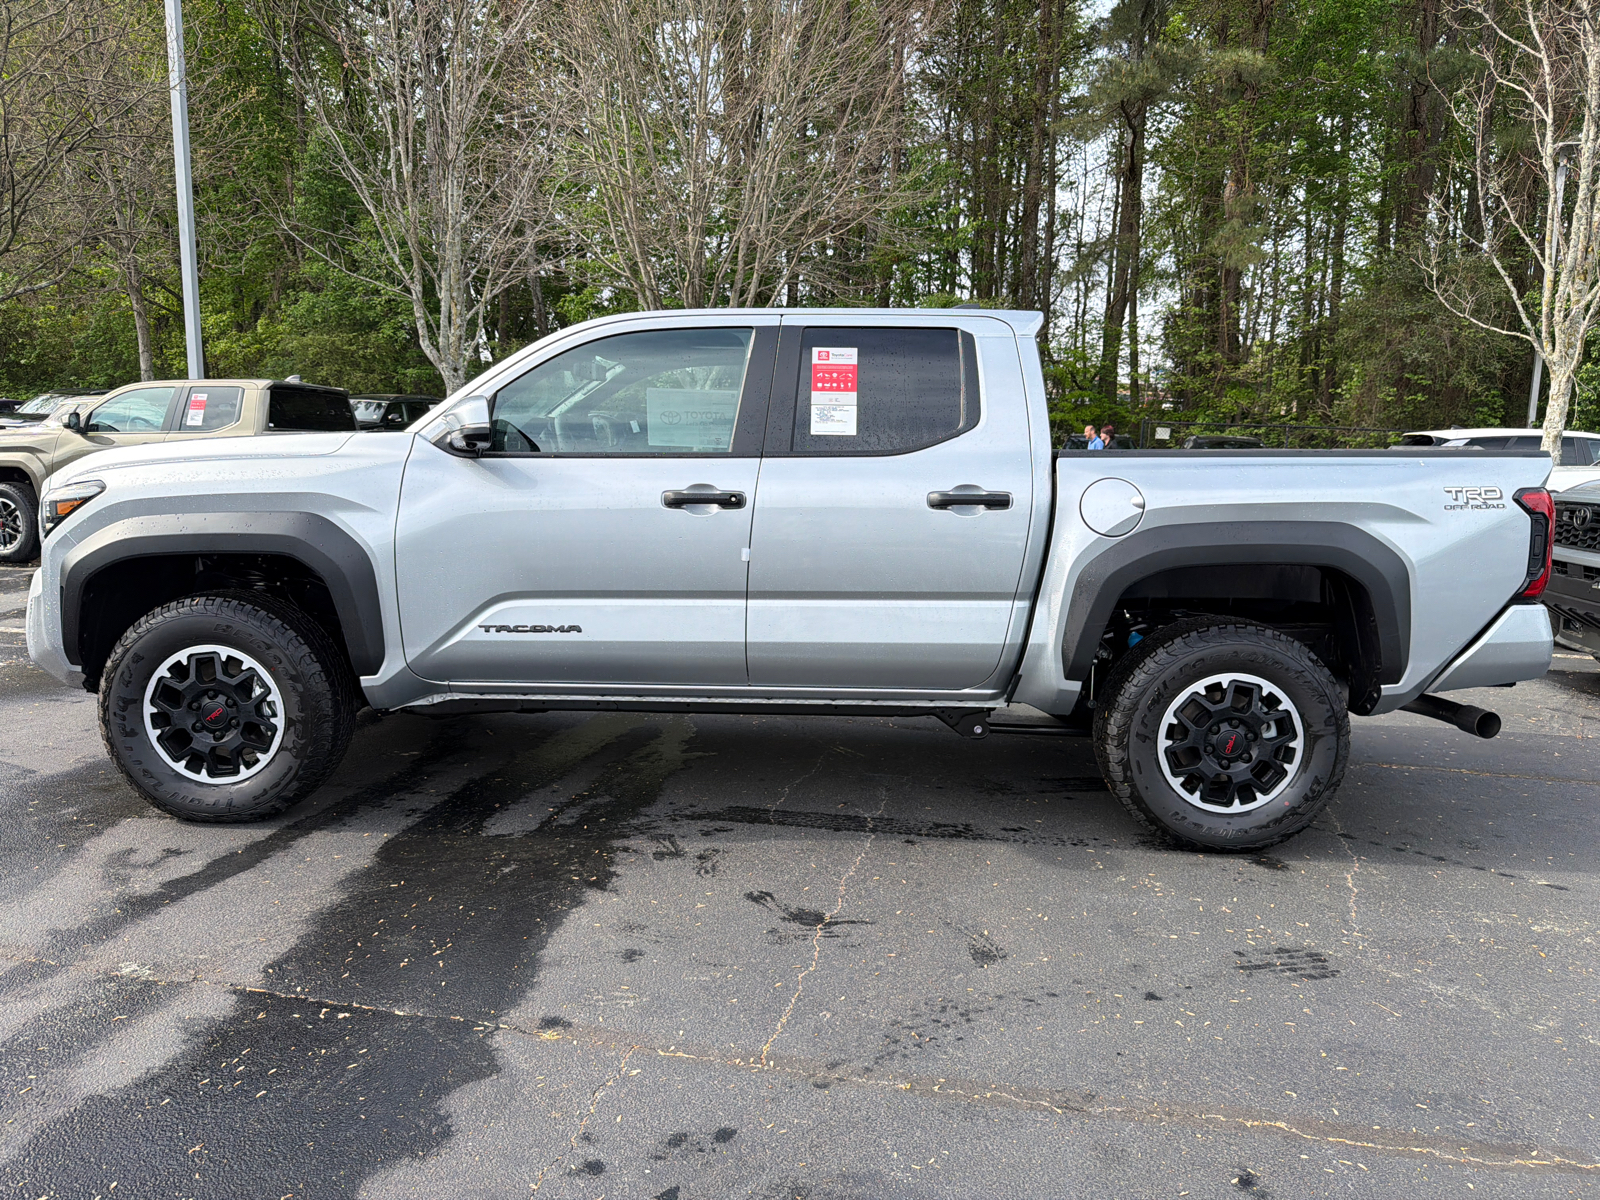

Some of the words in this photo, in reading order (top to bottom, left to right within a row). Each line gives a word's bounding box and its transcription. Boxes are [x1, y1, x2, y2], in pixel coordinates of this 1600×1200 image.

[684, 411, 727, 420] TOYOTA
[1443, 486, 1503, 504] TRD
[478, 625, 582, 633] TACOMA
[206, 708, 223, 721] TRD
[1225, 734, 1236, 754] TRD
